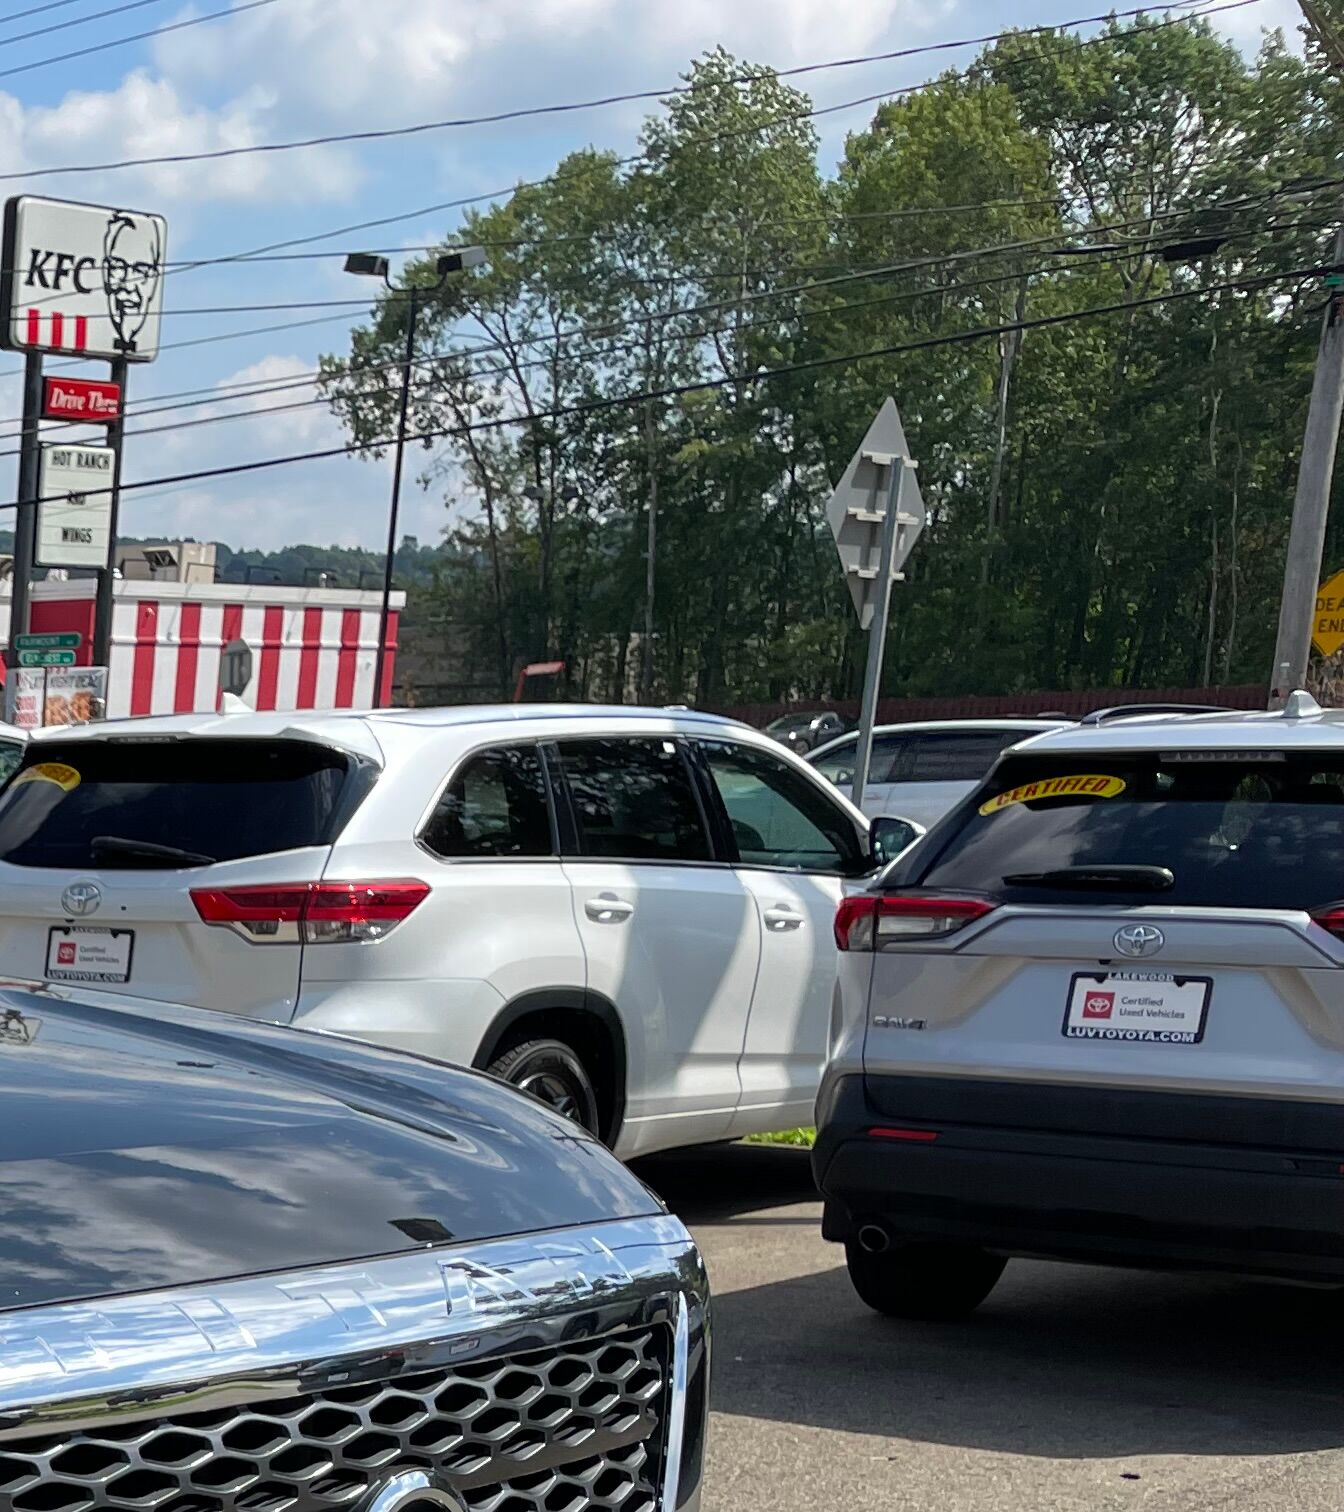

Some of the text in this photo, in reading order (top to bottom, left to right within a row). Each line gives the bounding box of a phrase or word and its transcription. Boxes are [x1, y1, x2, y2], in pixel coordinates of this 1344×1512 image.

[25, 248, 96, 293] KFC
[50, 387, 85, 410] Drive
[52, 449, 71, 467] HOT
[62, 528, 91, 543] WINGS
[1318, 618, 1344, 633] EN
[1108, 972, 1175, 982] LAKEWOOD
[1121, 996, 1164, 1006] Certified
[1119, 1007, 1185, 1019] Used Vehicles
[1067, 1025, 1196, 1044] LUVTOYOTA.COM
